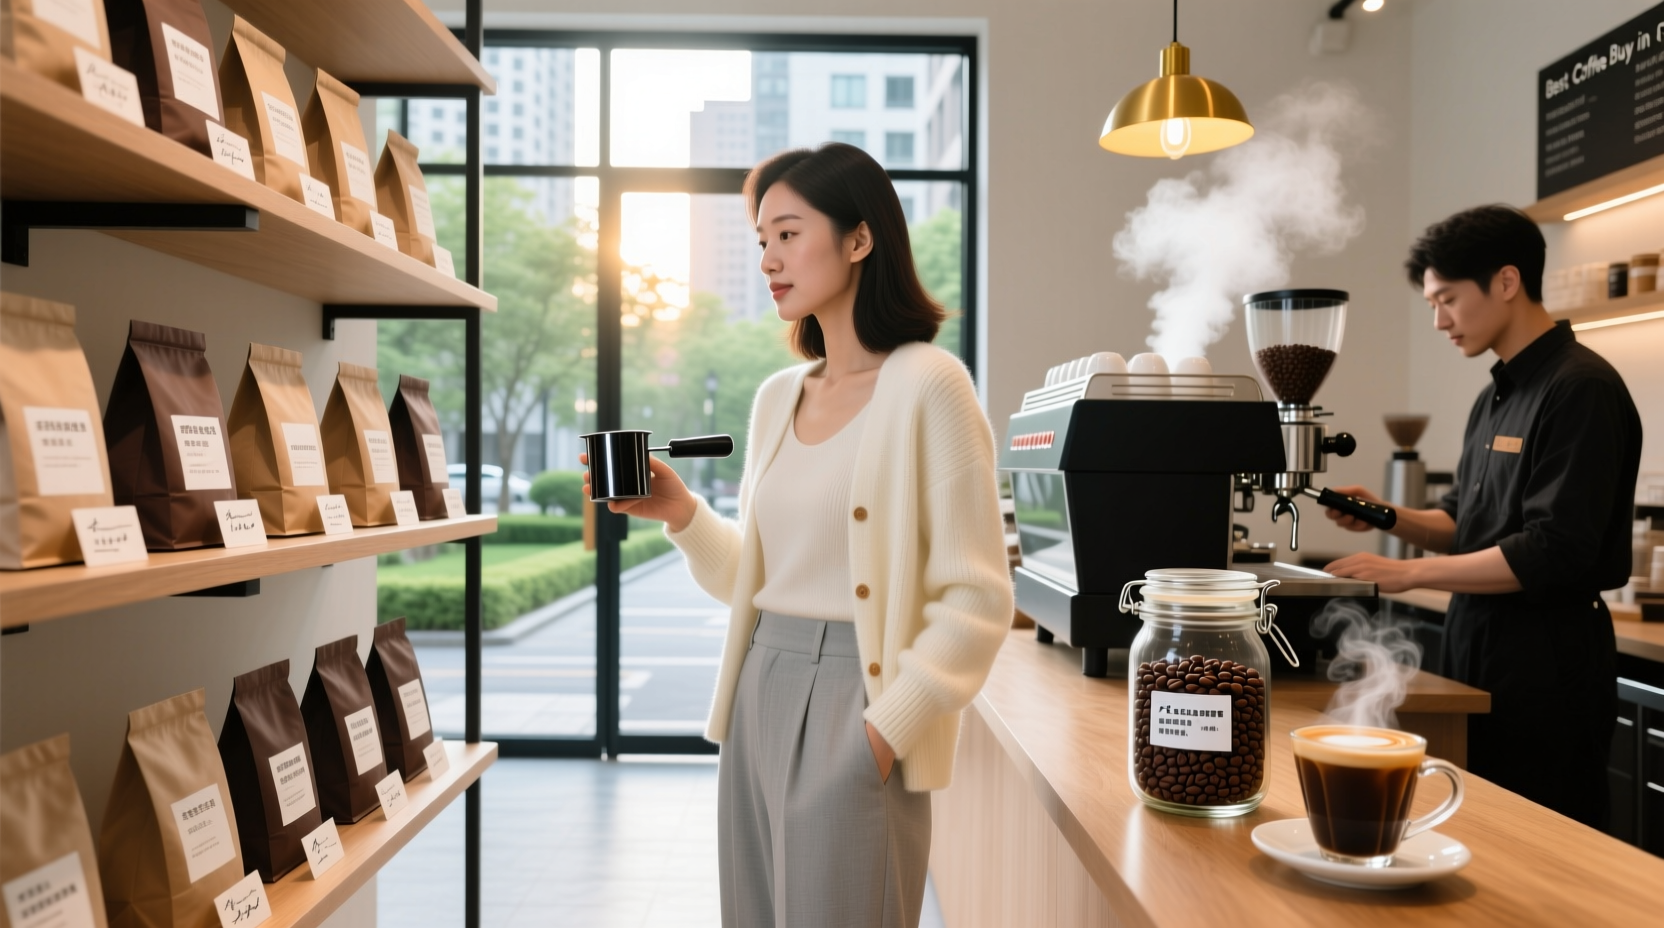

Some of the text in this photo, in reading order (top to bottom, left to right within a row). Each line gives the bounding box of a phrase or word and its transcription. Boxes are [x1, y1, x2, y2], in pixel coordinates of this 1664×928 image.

[1545, 72, 1569, 99] Best
[1572, 54, 1607, 85] Coffee
[1609, 41, 1634, 66] Buy
[1637, 31, 1650, 51] in
